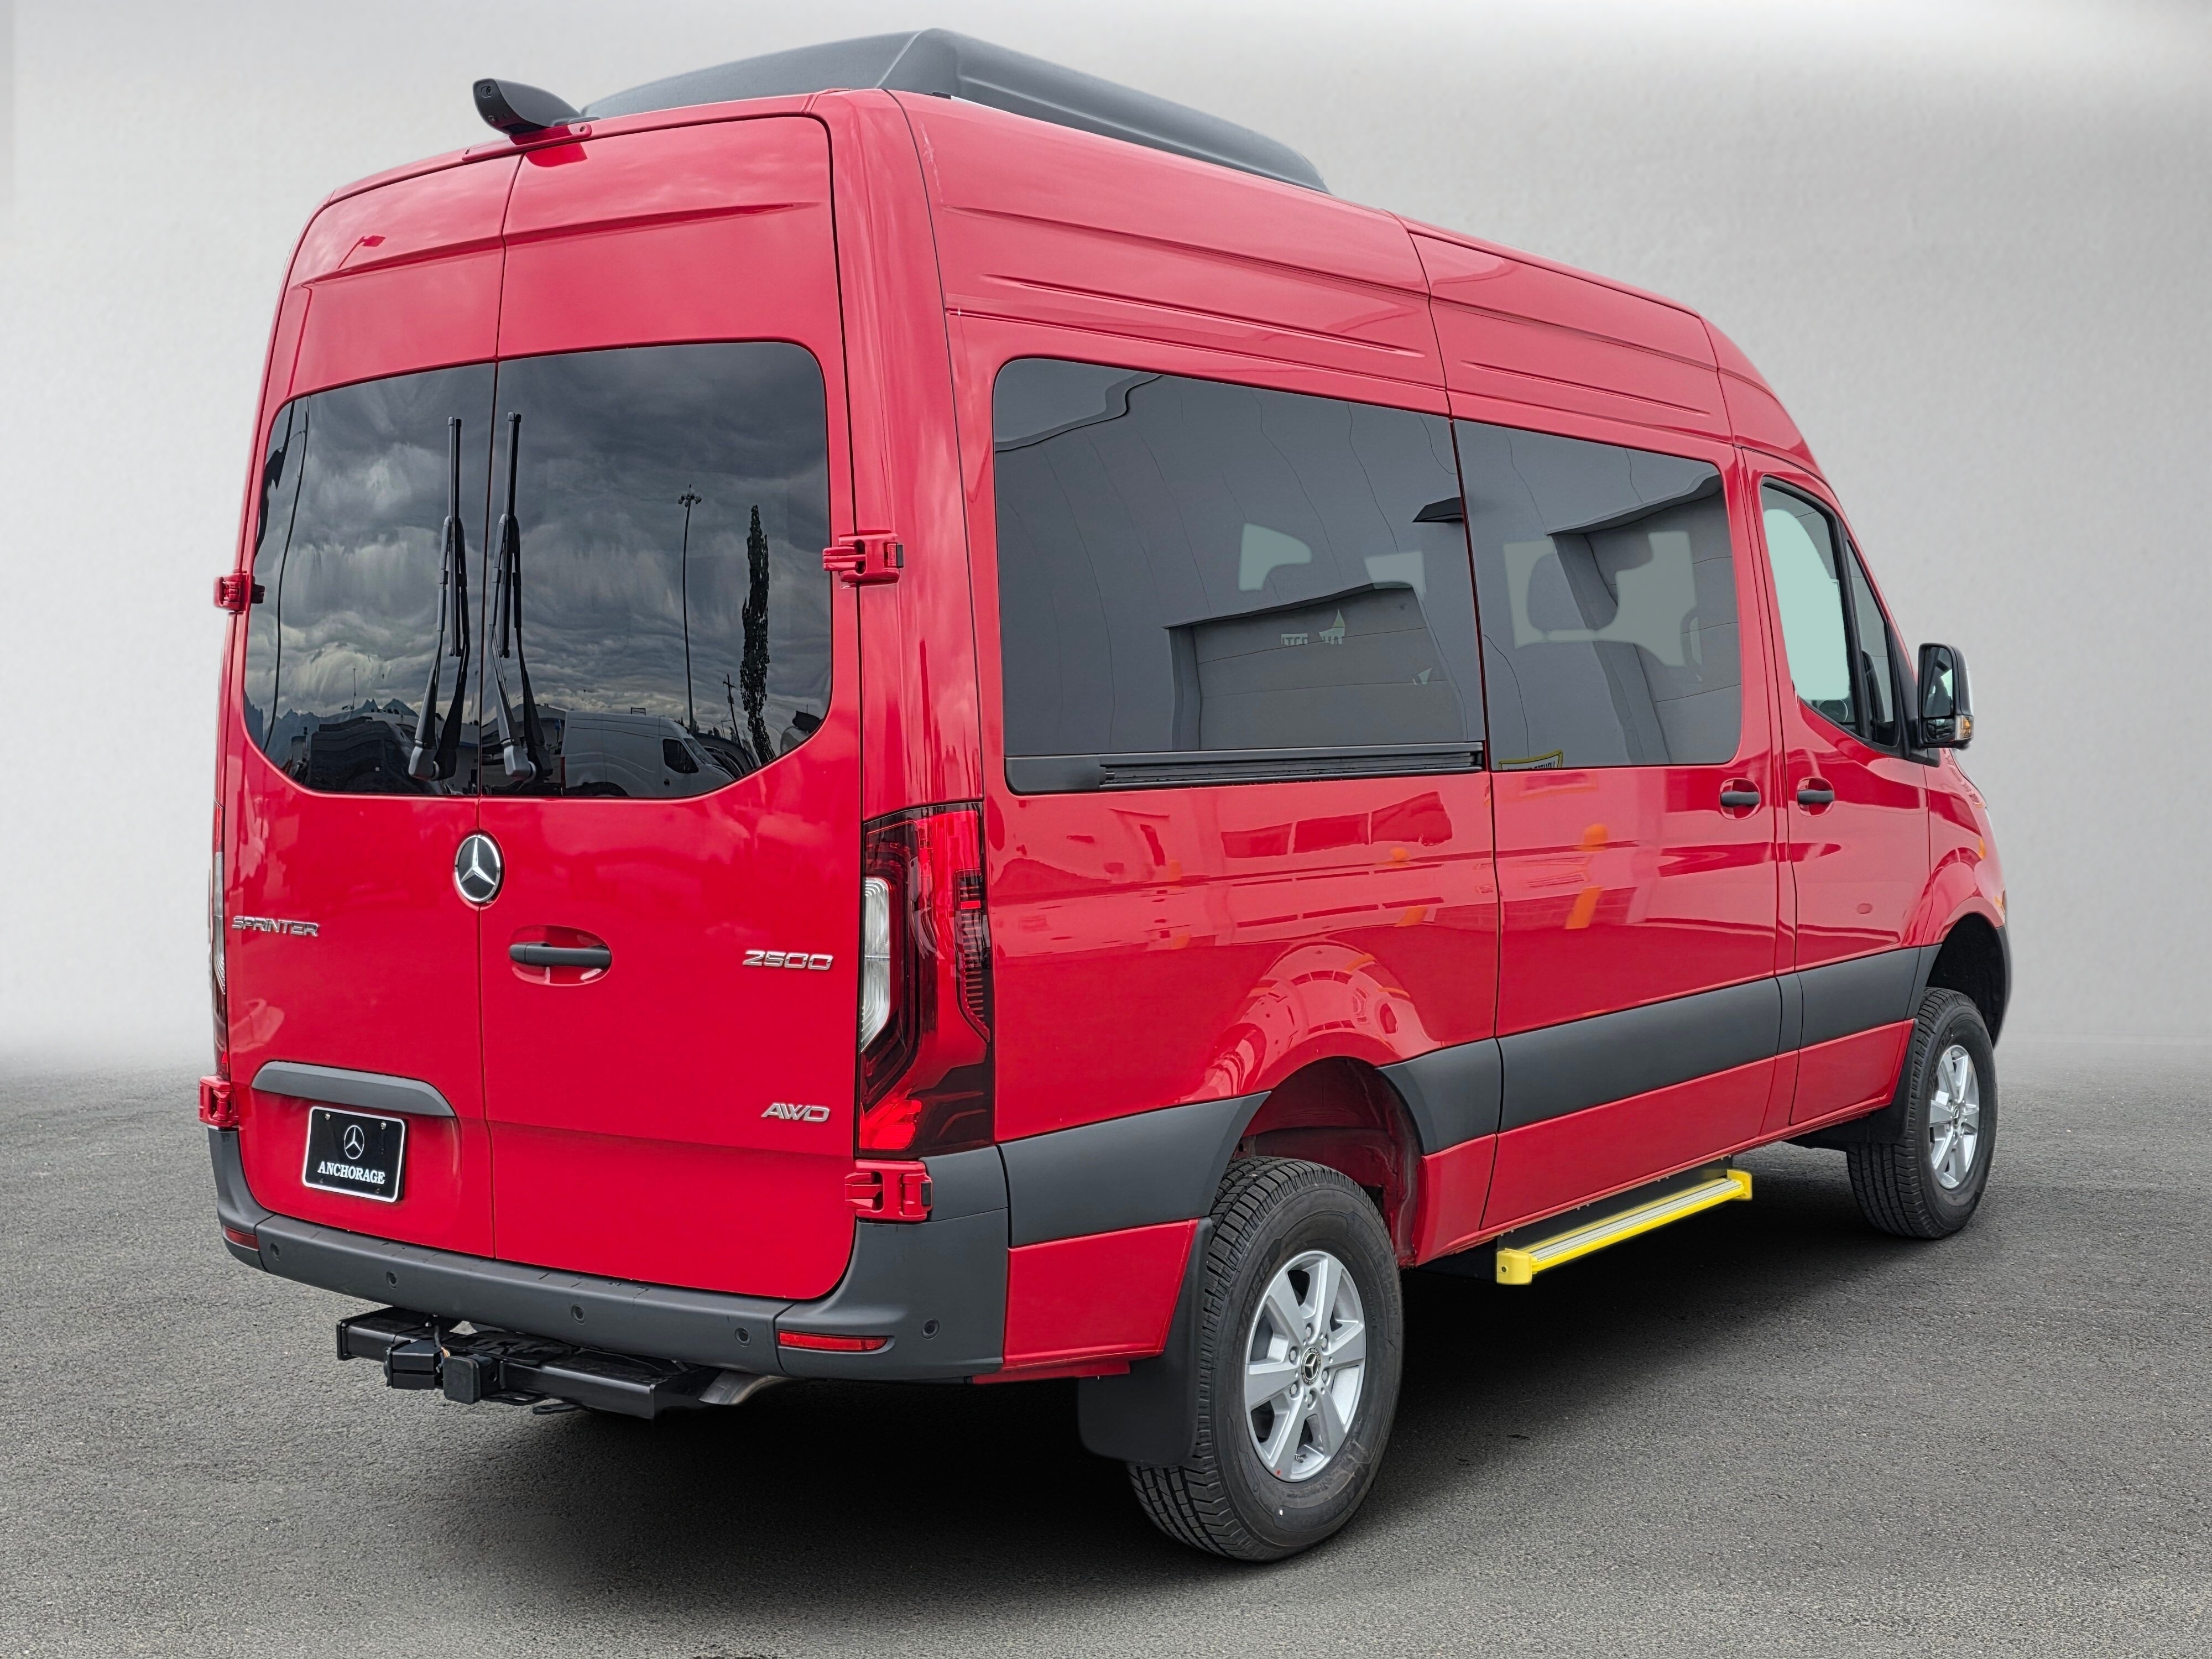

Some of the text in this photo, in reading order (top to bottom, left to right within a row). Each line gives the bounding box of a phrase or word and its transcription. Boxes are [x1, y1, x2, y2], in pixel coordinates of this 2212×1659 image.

[232, 915, 319, 937] SPRINTER
[742, 950, 833, 971] 2500
[761, 1103, 831, 1122] AWD
[317, 1161, 385, 1185] ANCHORAGE
